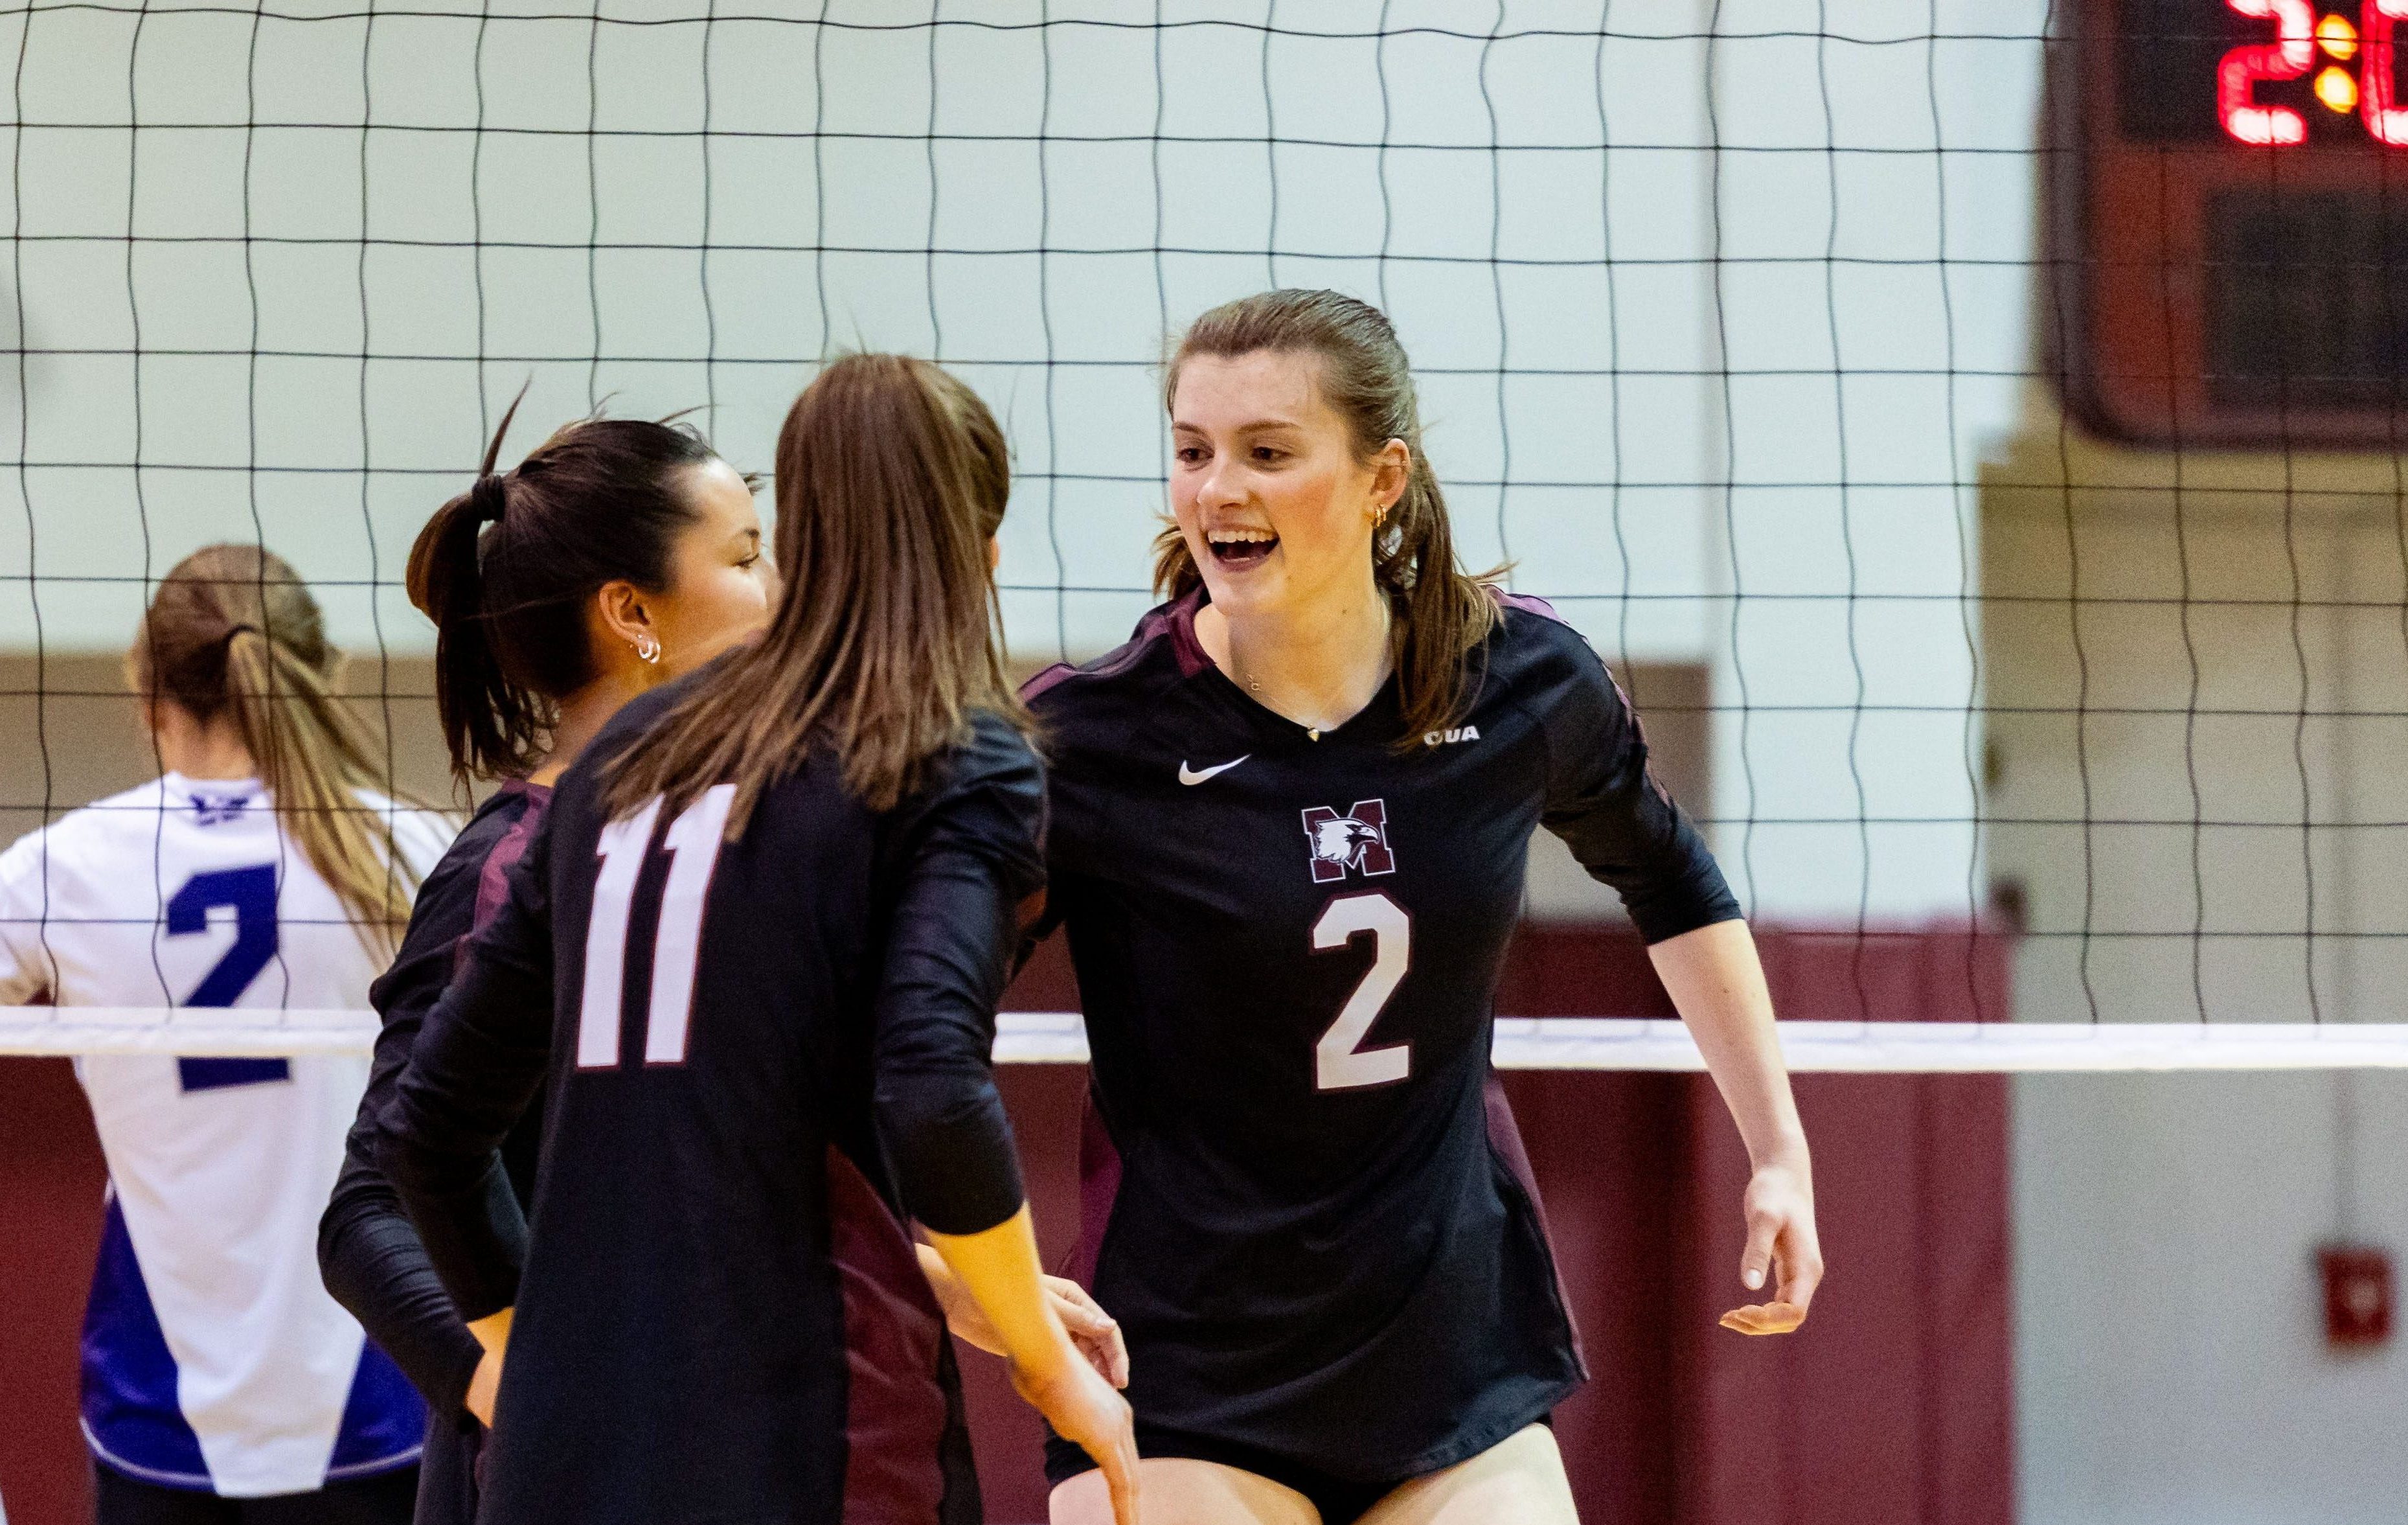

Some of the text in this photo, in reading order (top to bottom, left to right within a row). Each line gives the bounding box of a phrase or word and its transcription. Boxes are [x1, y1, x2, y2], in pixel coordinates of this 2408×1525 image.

[1424, 726, 1481, 745] OUA
[166, 862, 291, 1094] 2
[576, 783, 738, 1069] 11
[1310, 890, 1413, 1092] 2
